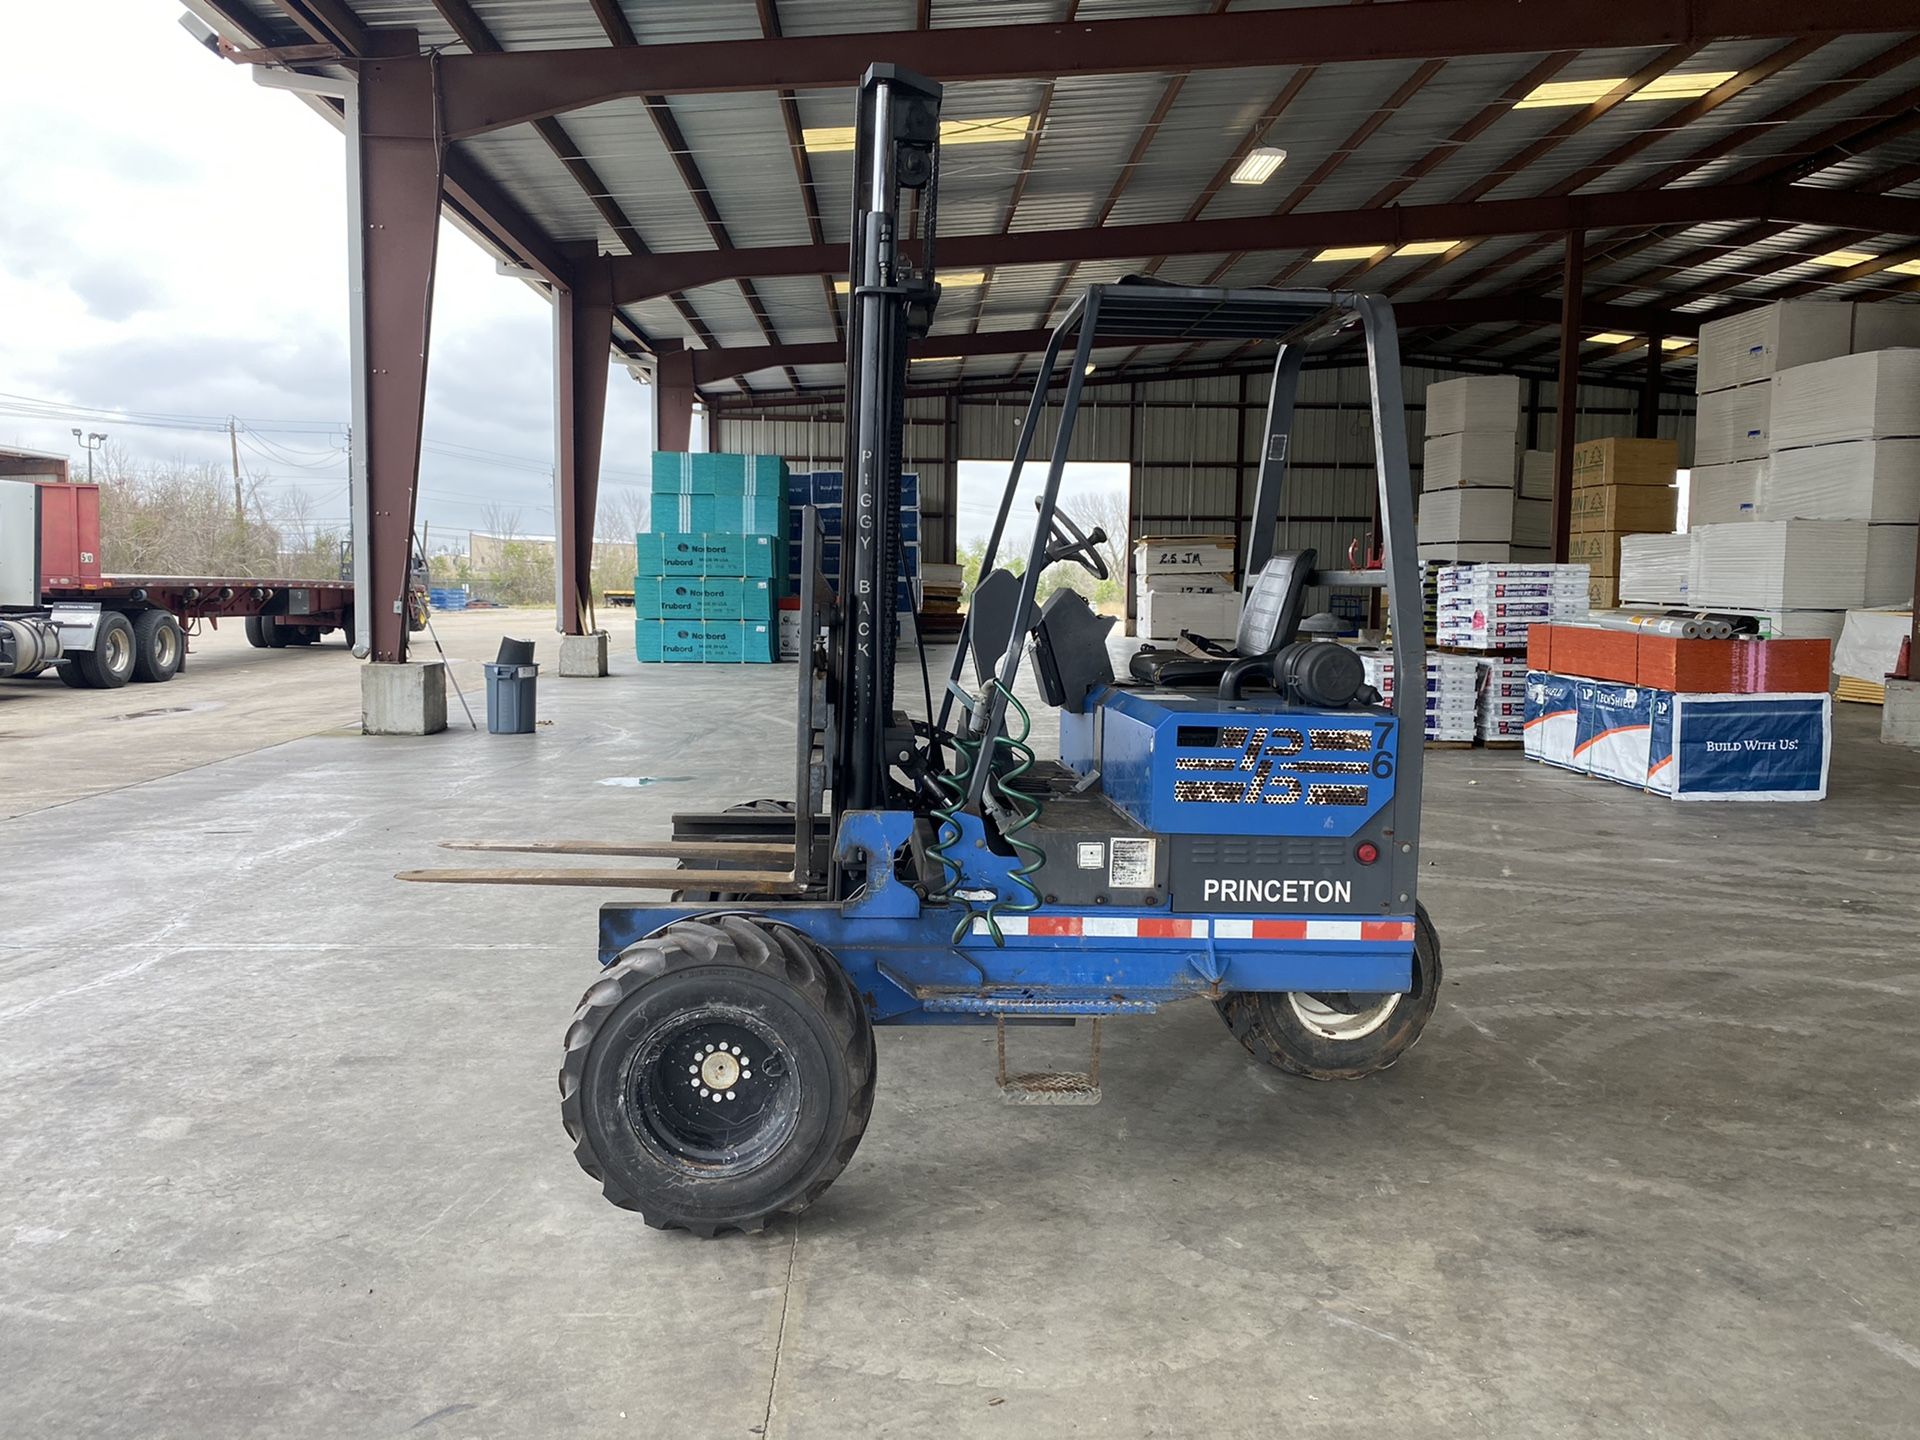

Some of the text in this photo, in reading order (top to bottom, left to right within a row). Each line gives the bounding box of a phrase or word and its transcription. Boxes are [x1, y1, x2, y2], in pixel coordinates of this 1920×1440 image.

[692, 545, 726, 553] Nobord
[857, 450, 873, 656] PIGGY BACK
[1570, 540, 1586, 556] UNT
[690, 590, 724, 598] Nobord
[661, 602, 691, 610] Trubord
[1657, 701, 1668, 714] LP
[1203, 879, 1351, 903] PRINCETON
